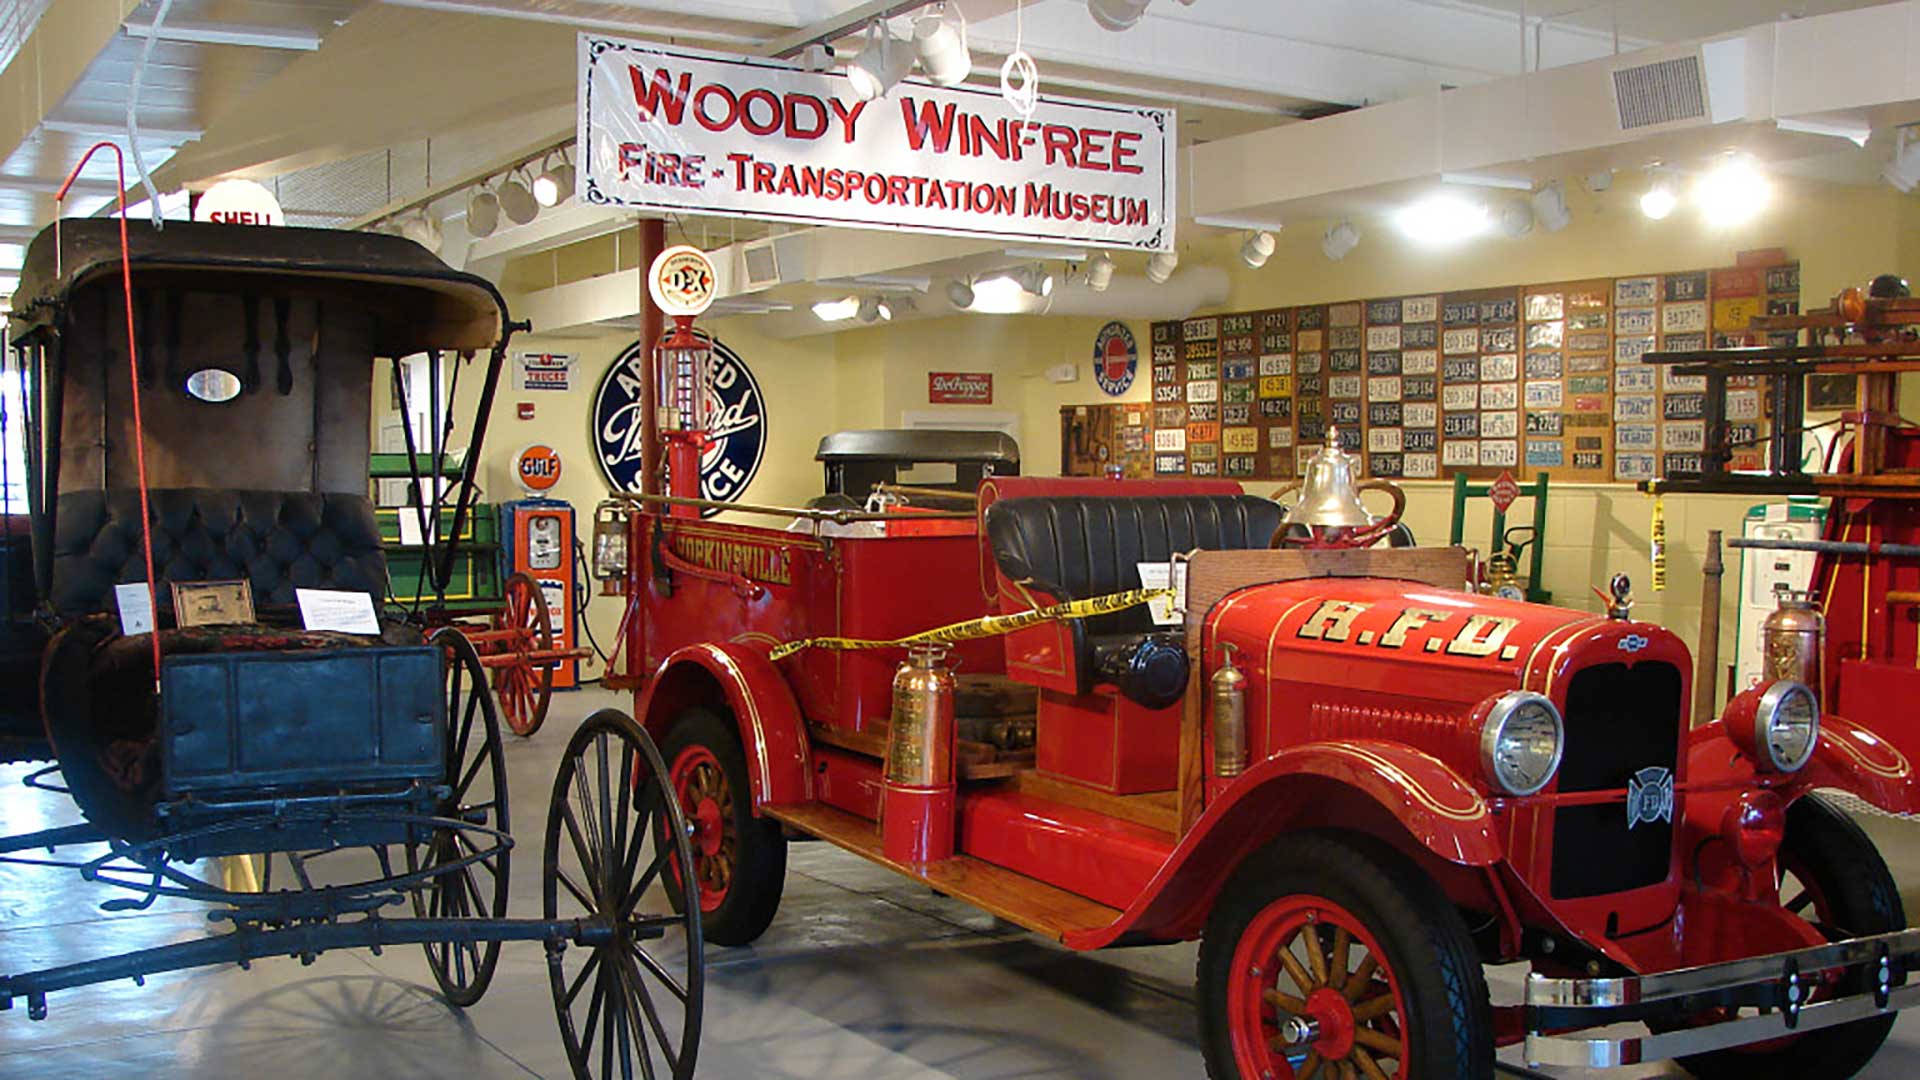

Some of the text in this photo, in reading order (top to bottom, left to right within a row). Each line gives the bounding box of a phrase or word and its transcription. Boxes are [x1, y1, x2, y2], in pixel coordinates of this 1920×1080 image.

[627, 64, 1144, 174] WOODY WINFREE
[618, 142, 704, 188] FIRE
[727, 152, 1016, 216] TRANSPORTATION
[1023, 183, 1149, 227] MUSEUM
[520, 459, 556, 477] GULF
